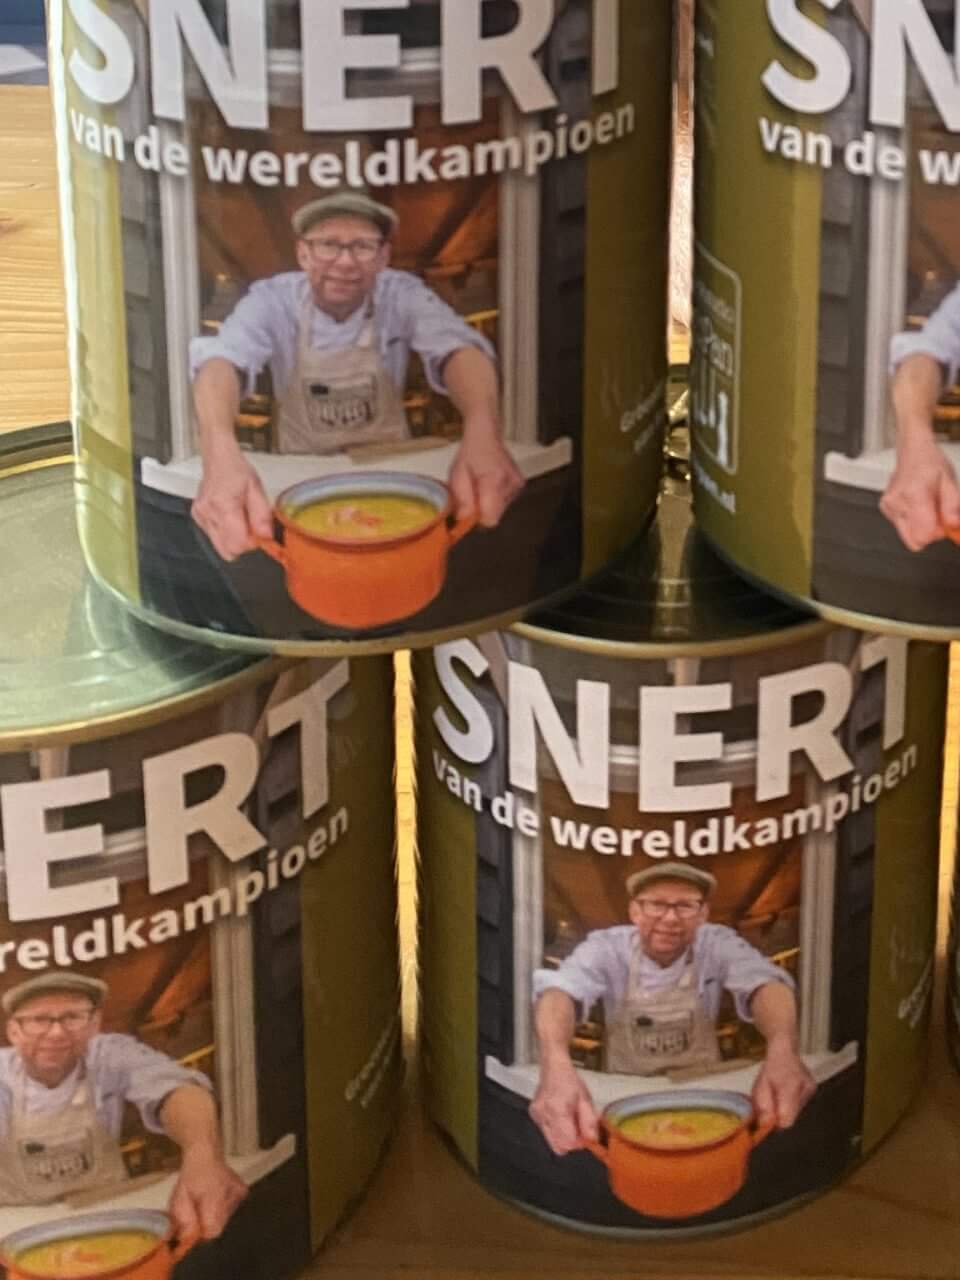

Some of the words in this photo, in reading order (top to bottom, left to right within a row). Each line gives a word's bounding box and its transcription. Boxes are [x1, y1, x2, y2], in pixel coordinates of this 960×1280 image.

[70, 104, 126, 163] van
[133, 122, 190, 175] de
[203, 101, 635, 188] wereldkampioen
[759, 116, 832, 170] van
[845, 124, 904, 180] de
[0, 657, 350, 923] ERT
[432, 636, 910, 813] SNERT
[432, 749, 483, 813] van
[490, 790, 541, 838] de
[550, 743, 917, 859] wereldkampioen
[0, 806, 348, 971] reldkampioen
